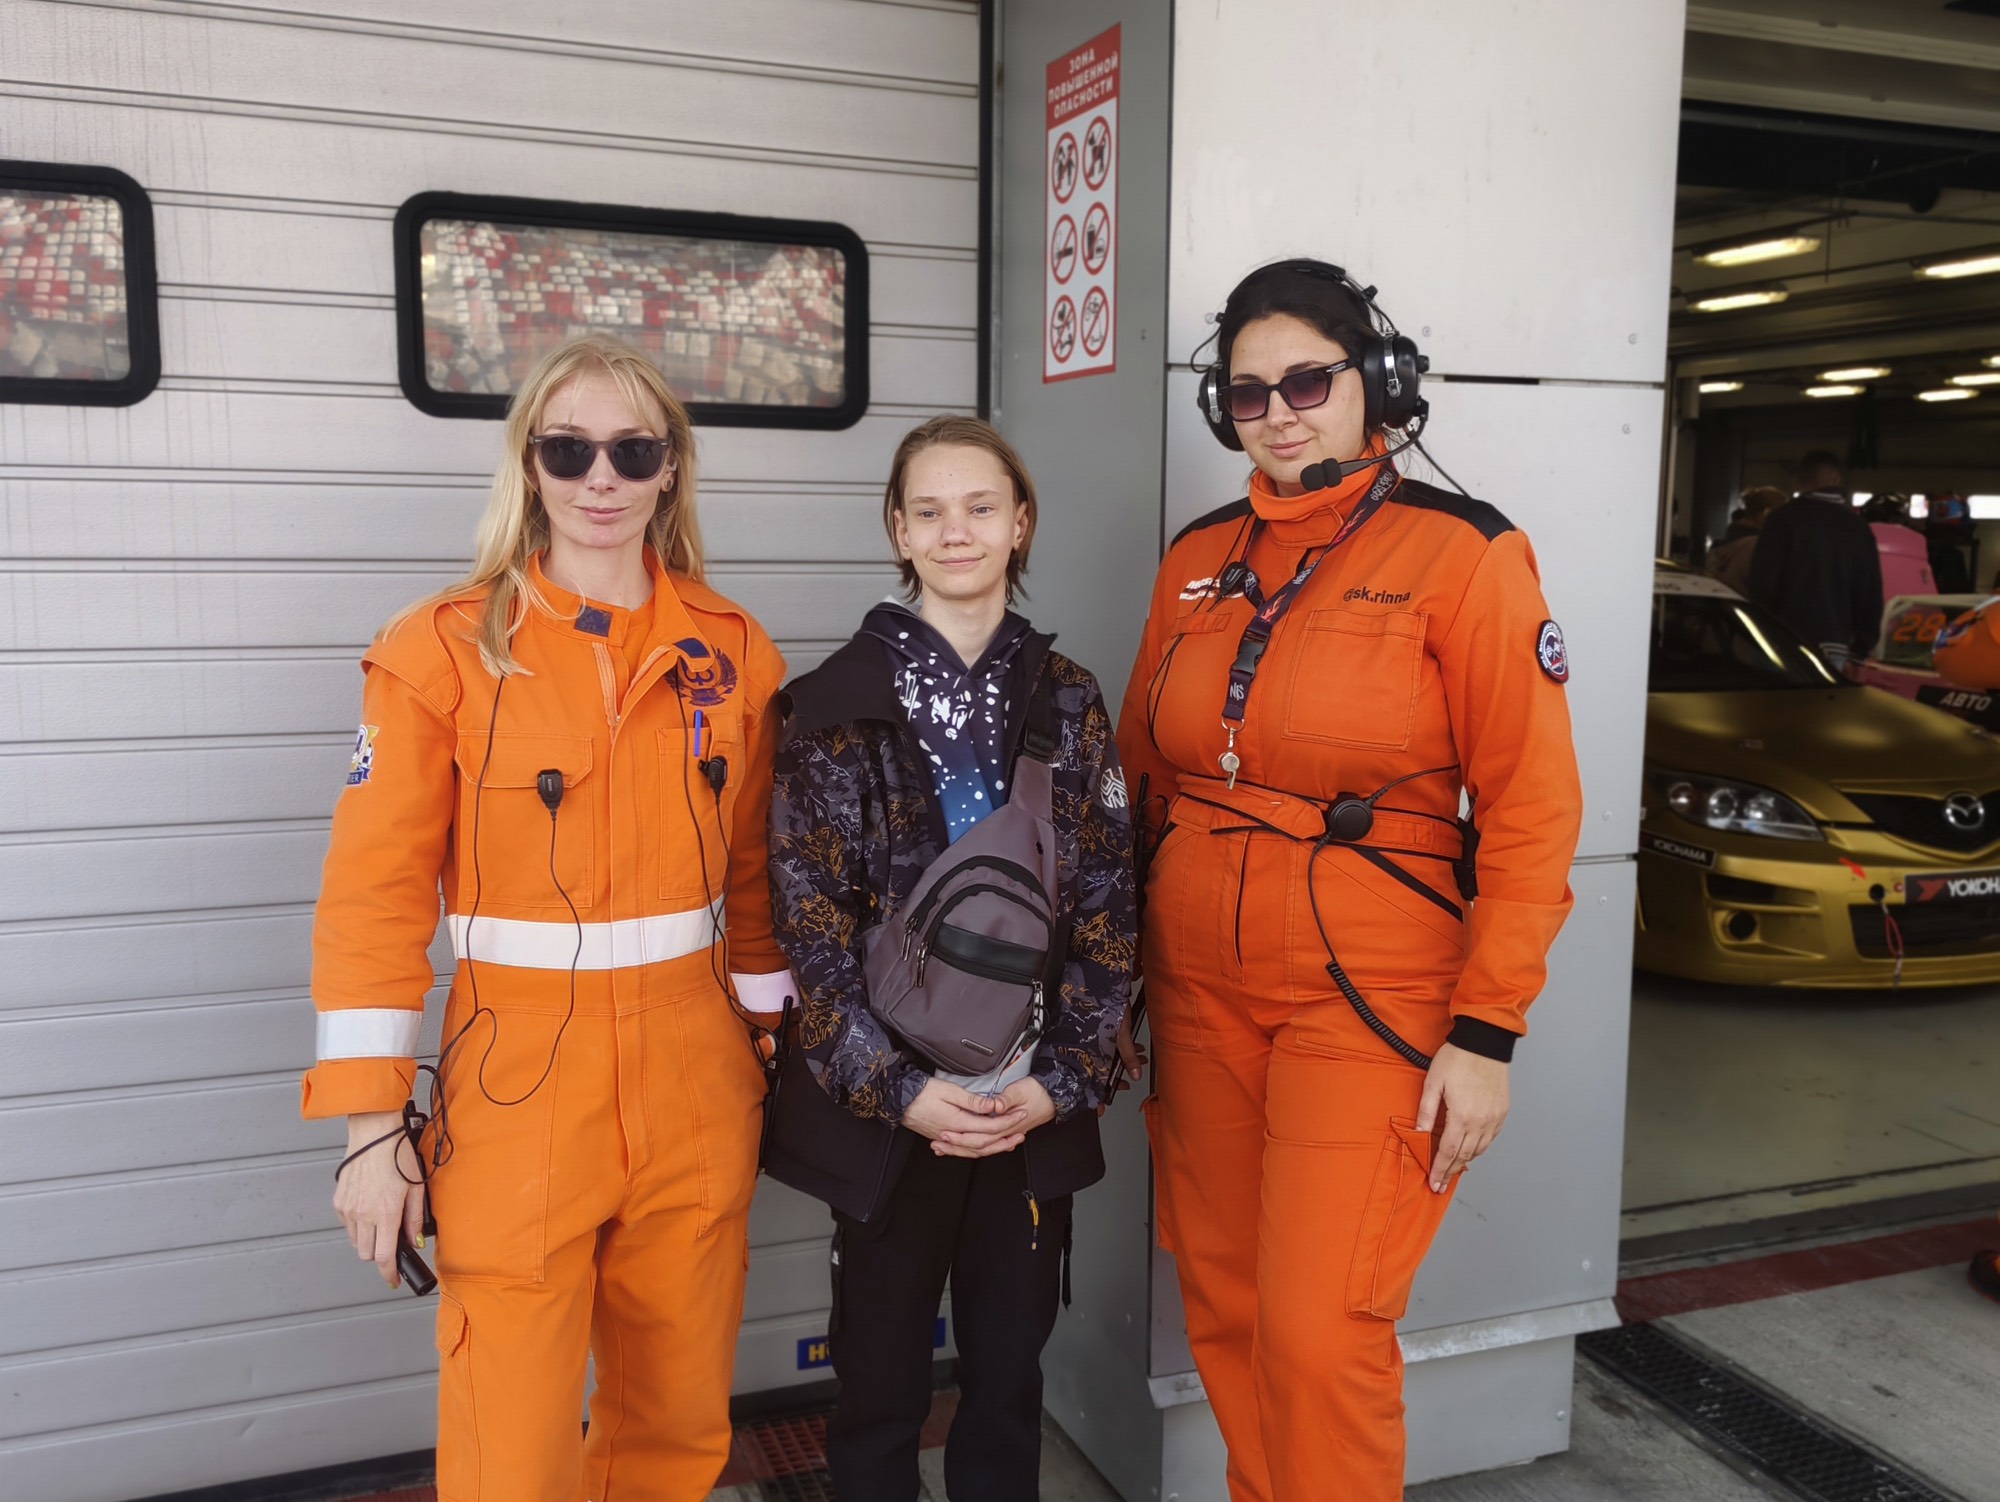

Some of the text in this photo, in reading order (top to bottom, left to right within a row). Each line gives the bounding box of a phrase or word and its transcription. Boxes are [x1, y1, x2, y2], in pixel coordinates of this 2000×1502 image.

[1069, 48, 1095, 74] ЗОНА
[1048, 50, 1118, 104] ПОВЫШЕННОЙ
[1054, 76, 1114, 119] ОПАСНОСТИ
[1343, 586, 1411, 605] @sk.rinna
[1947, 876, 2000, 897] YOKOH
